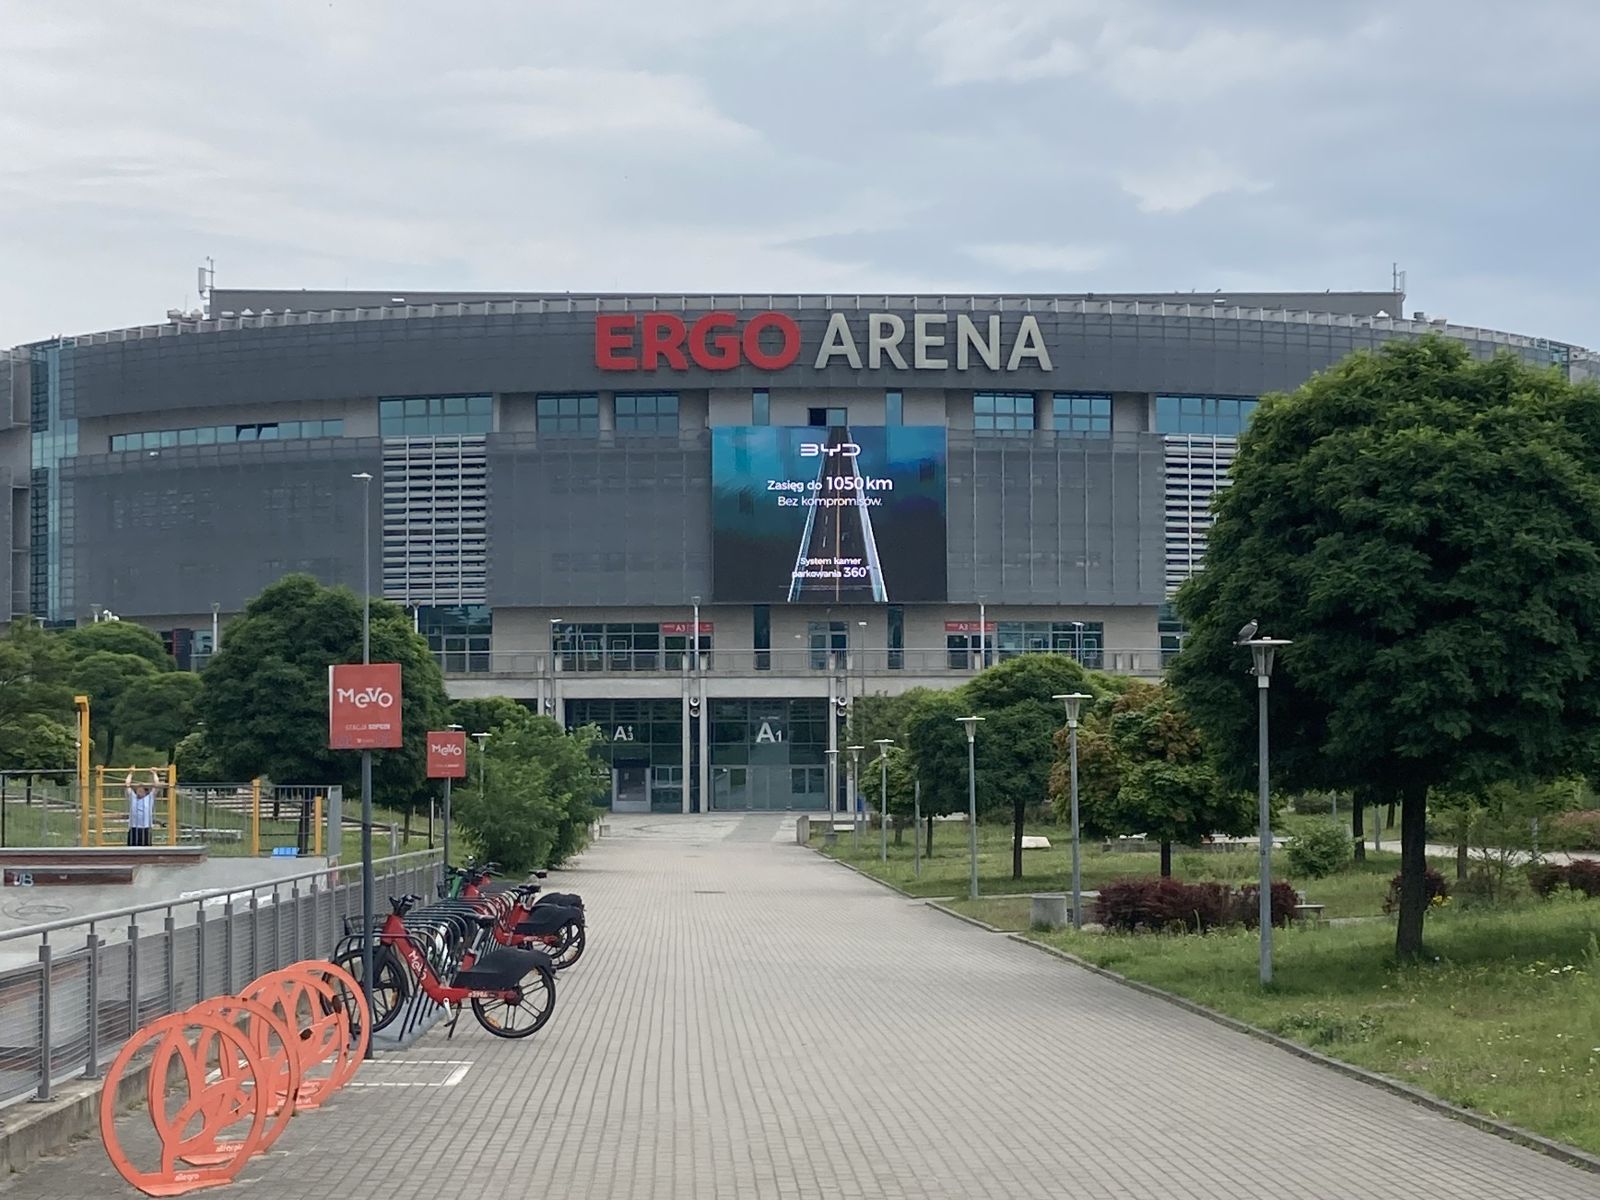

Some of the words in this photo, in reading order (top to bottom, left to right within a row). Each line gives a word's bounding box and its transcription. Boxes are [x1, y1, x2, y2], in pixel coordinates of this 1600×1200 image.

[595, 311, 800, 371] ERGO
[814, 312, 1053, 371] ARENA
[800, 443, 861, 457] BYD
[767, 480, 804, 492] Zasięg
[807, 479, 823, 491] do
[778, 496, 799, 507] Bez
[801, 495, 882, 508] kompromisów.
[800, 557, 832, 567] System
[833, 557, 861, 565] kamer
[792, 569, 842, 579] parkowania
[756, 721, 782, 743] A1
